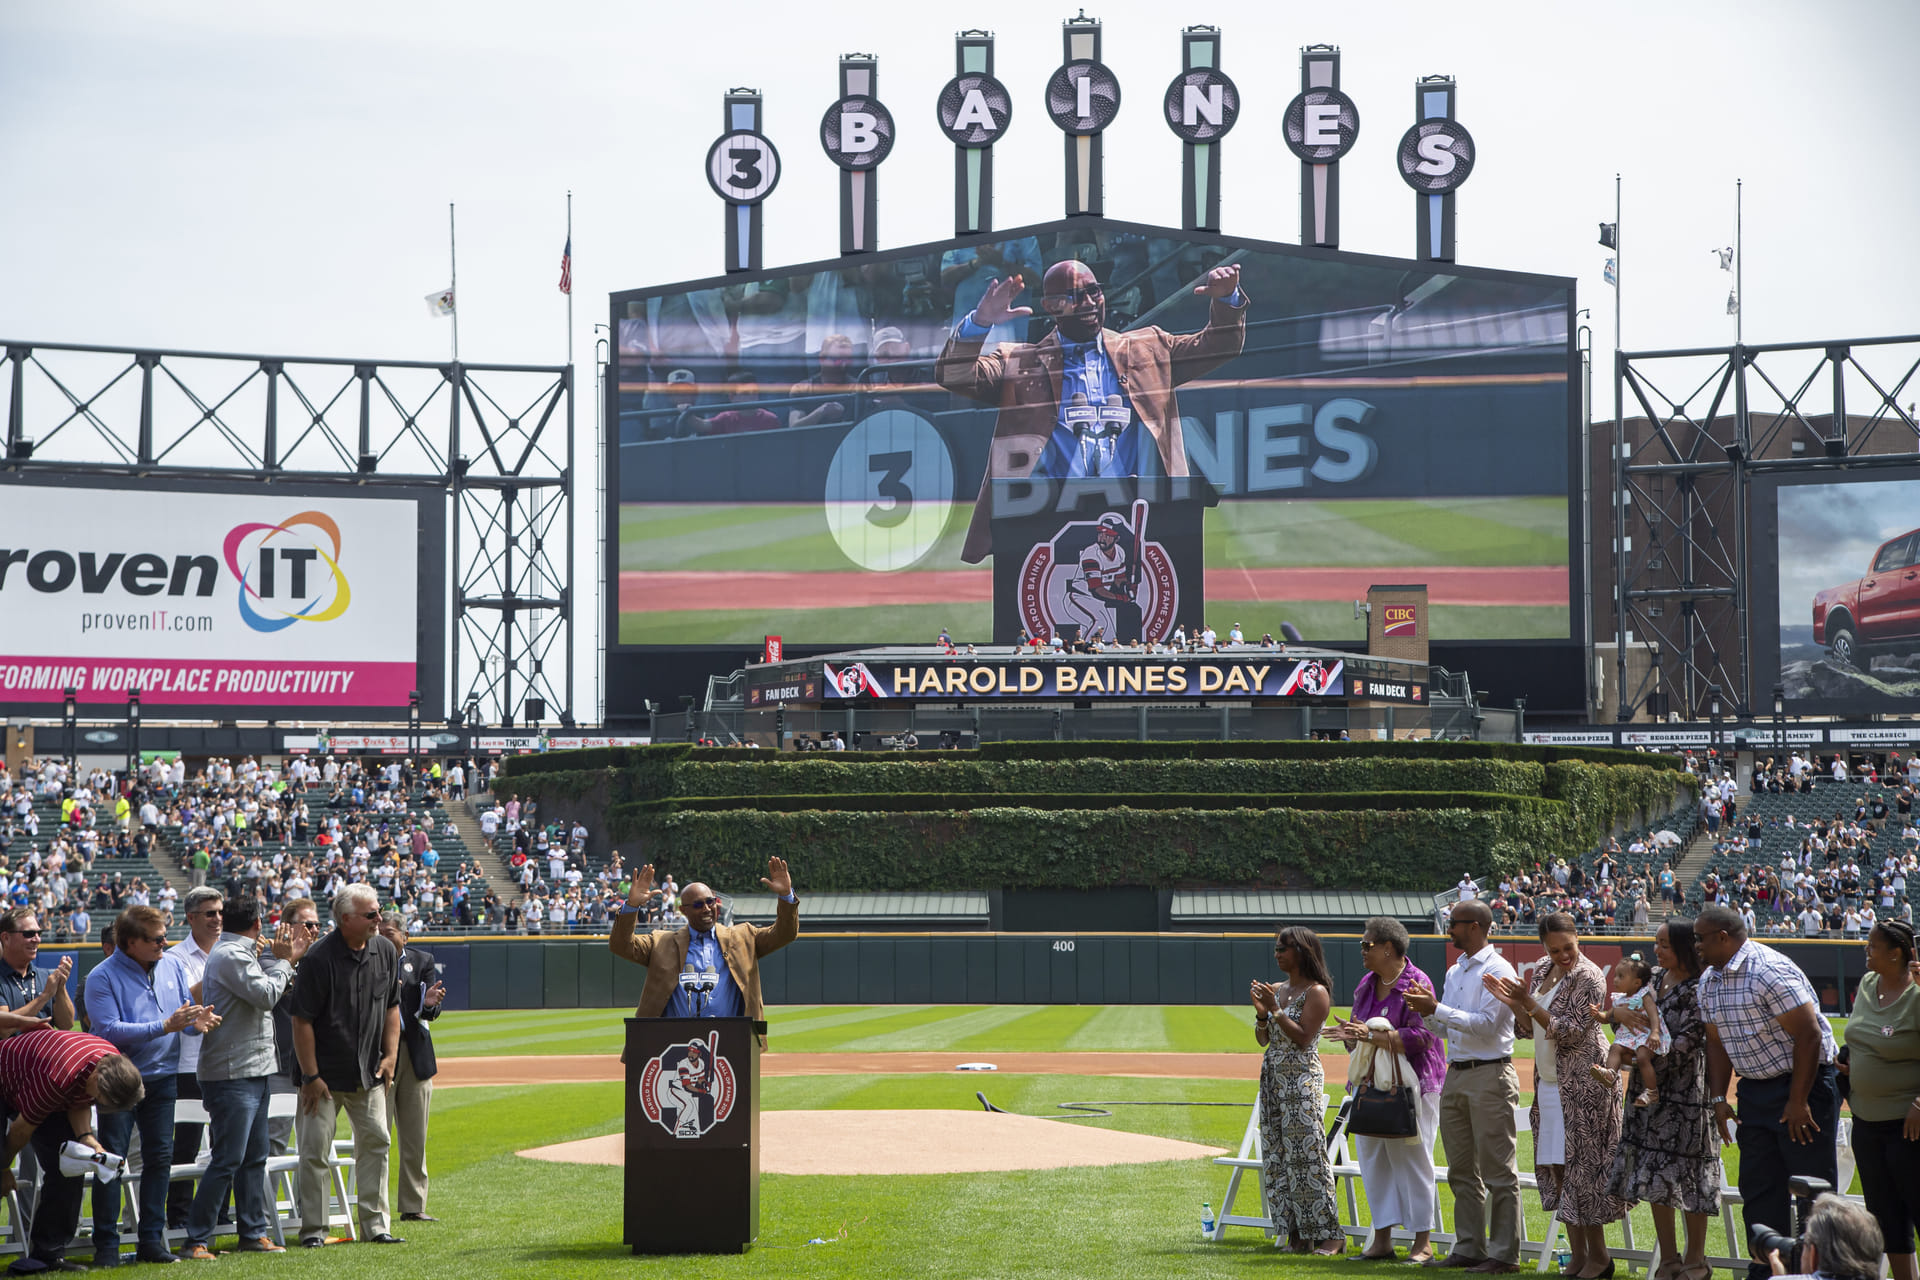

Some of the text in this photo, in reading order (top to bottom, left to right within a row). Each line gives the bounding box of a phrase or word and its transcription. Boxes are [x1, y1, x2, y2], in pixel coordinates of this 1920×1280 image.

[954, 88, 997, 131] A
[1183, 83, 1223, 126] N
[1304, 104, 1341, 146] E
[840, 112, 877, 154] B
[728, 148, 762, 188] 3
[1416, 134, 1455, 176] S
[864, 449, 913, 528] 3
[259, 548, 317, 599] IT
[1148, 550, 1171, 638] HALL OF FAME 2019
[1027, 553, 1047, 636] HAROLD BAINES
[1385, 609, 1415, 620] CIBC
[82, 611, 213, 633] provenIT.com
[92, 666, 212, 692] WORKPLACE
[214, 669, 354, 694] PRODUCTIVITY
[765, 688, 780, 701] FAN
[780, 686, 799, 699] DECK
[893, 665, 1271, 693] HAROLD BAINES DAY
[1369, 683, 1385, 695] FAN
[1386, 685, 1406, 698] DECK
[1053, 941, 1075, 951] 400
[645, 1089, 657, 1115] HAROLD
